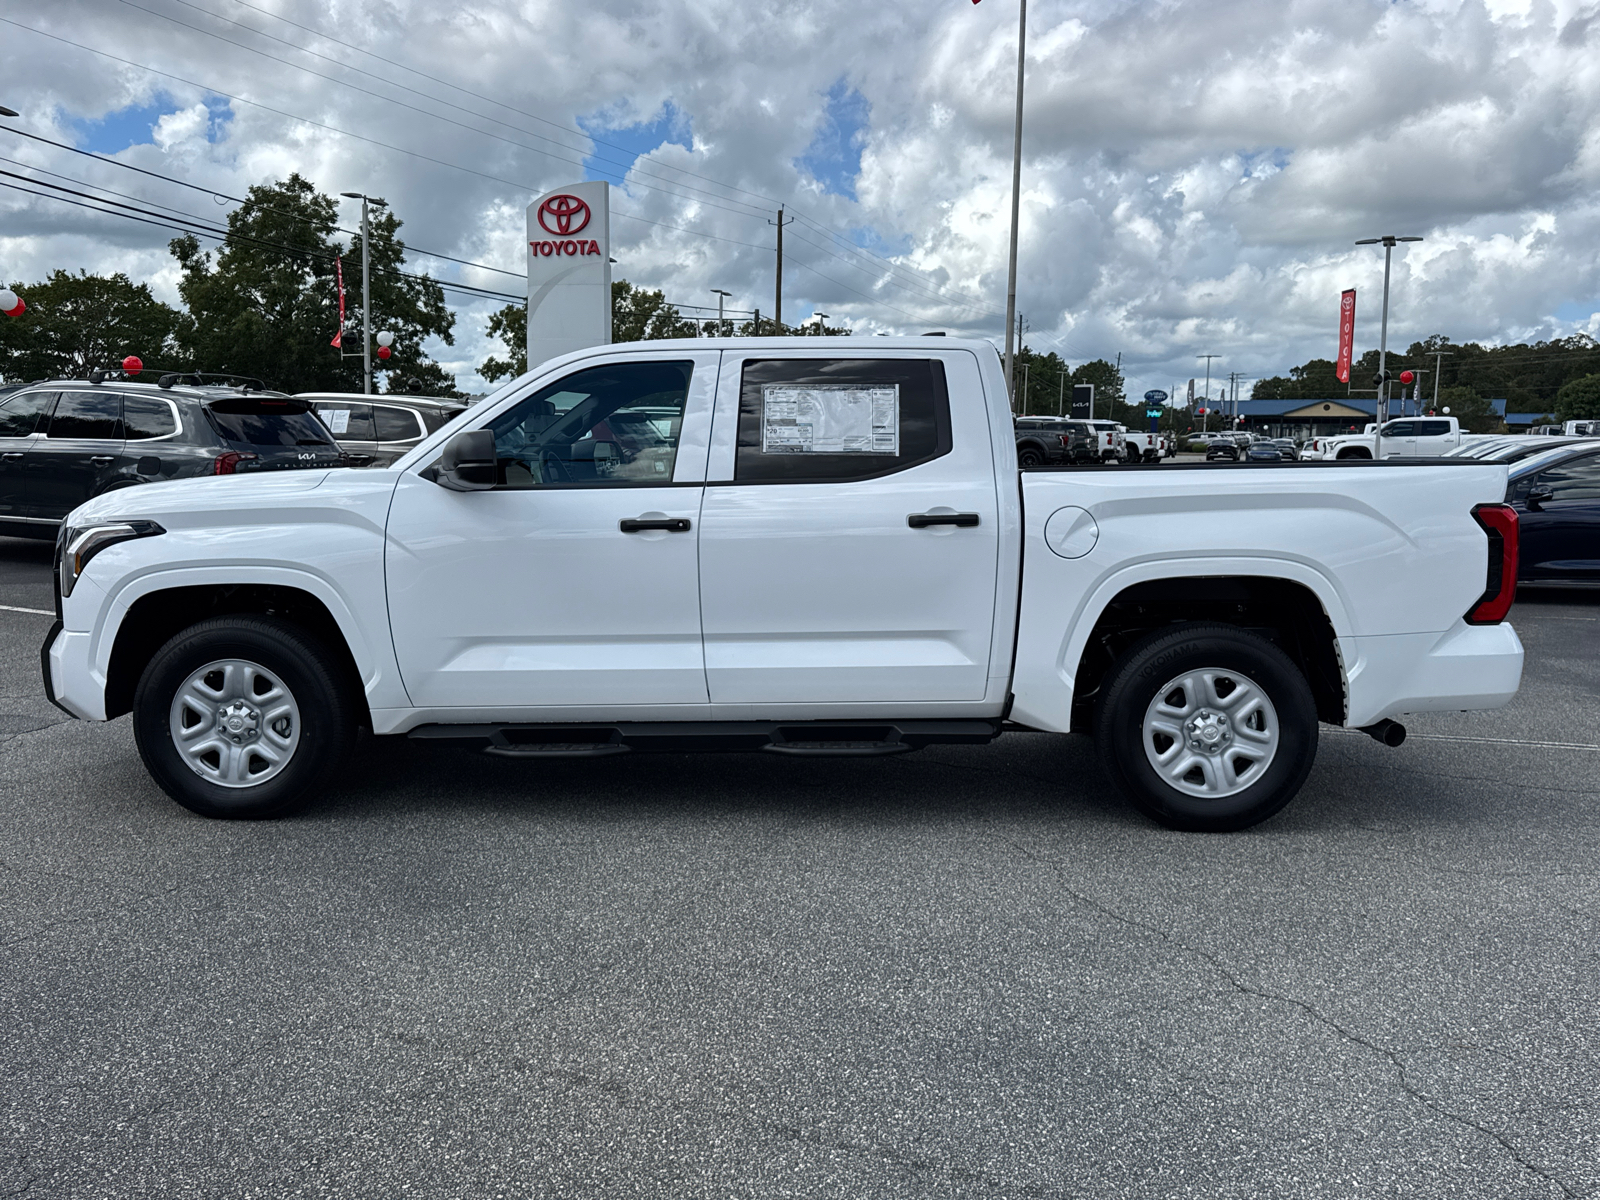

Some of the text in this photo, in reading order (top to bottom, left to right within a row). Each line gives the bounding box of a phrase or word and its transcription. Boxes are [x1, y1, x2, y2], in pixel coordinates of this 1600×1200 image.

[529, 240, 601, 257] TOYOTA
[1341, 311, 1351, 379] TOYOTA
[1137, 643, 1200, 679] YOKOHAMA
